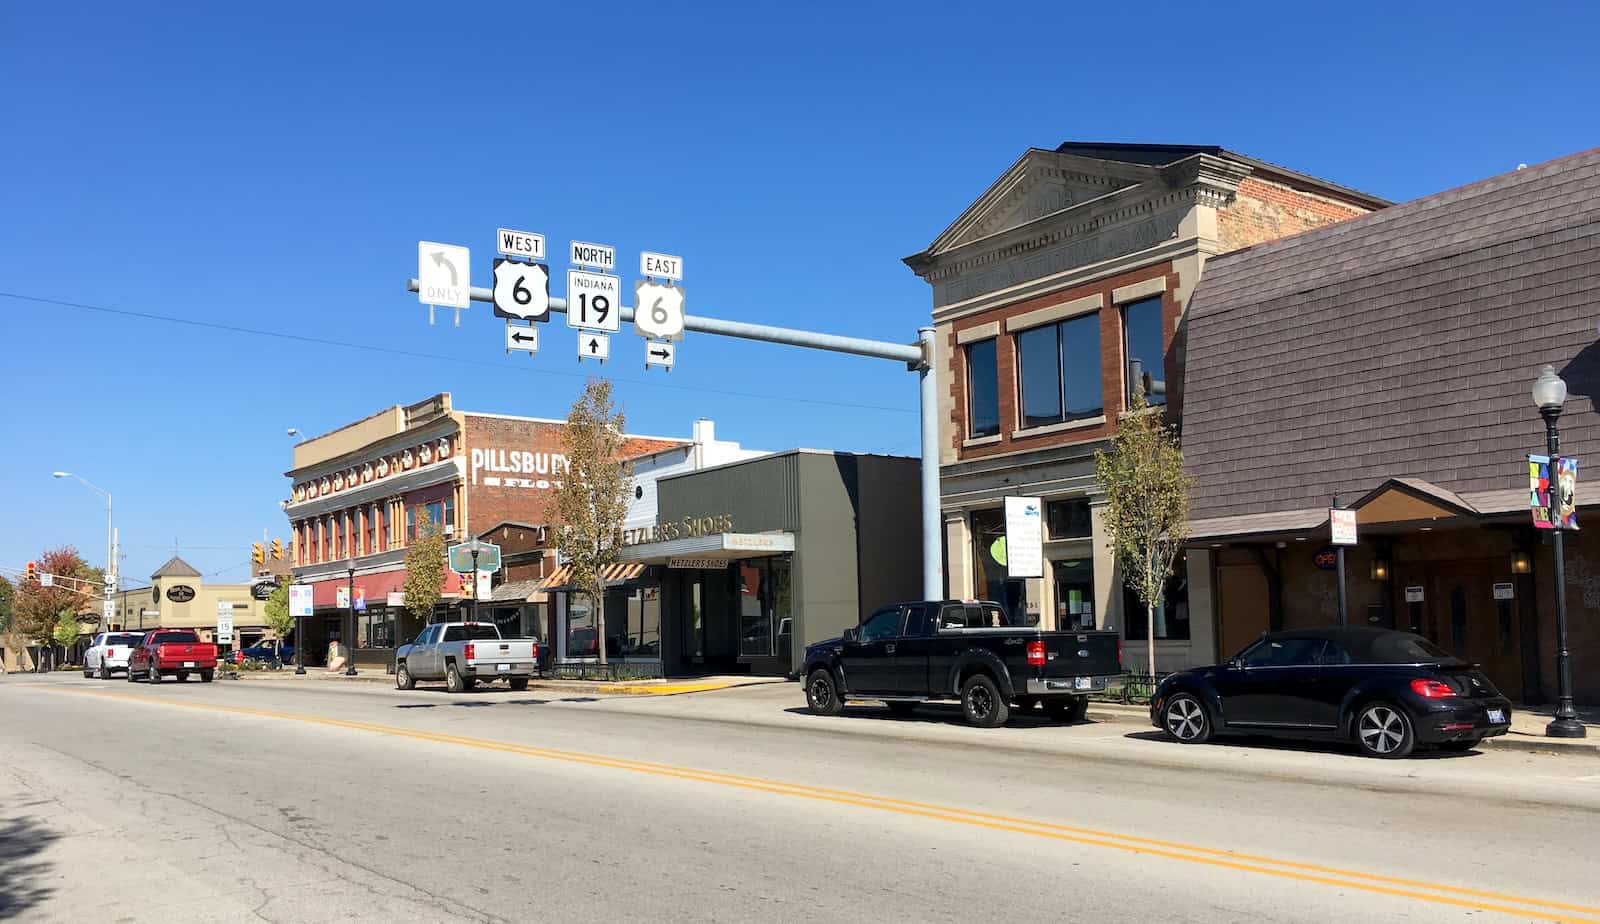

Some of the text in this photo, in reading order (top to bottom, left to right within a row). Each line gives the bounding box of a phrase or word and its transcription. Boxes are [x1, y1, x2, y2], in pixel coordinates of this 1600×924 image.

[503, 233, 540, 253] WEST
[574, 246, 612, 265] NORTH
[647, 257, 677, 274] EAST
[427, 286, 461, 301] ONLY
[512, 275, 532, 305] 6
[574, 277, 614, 291] INDIANA
[579, 293, 610, 324] 19
[651, 296, 668, 325] 6
[471, 448, 572, 485] PILLSBURY
[683, 514, 733, 537] SHOES
[1315, 553, 1336, 564] OPE
